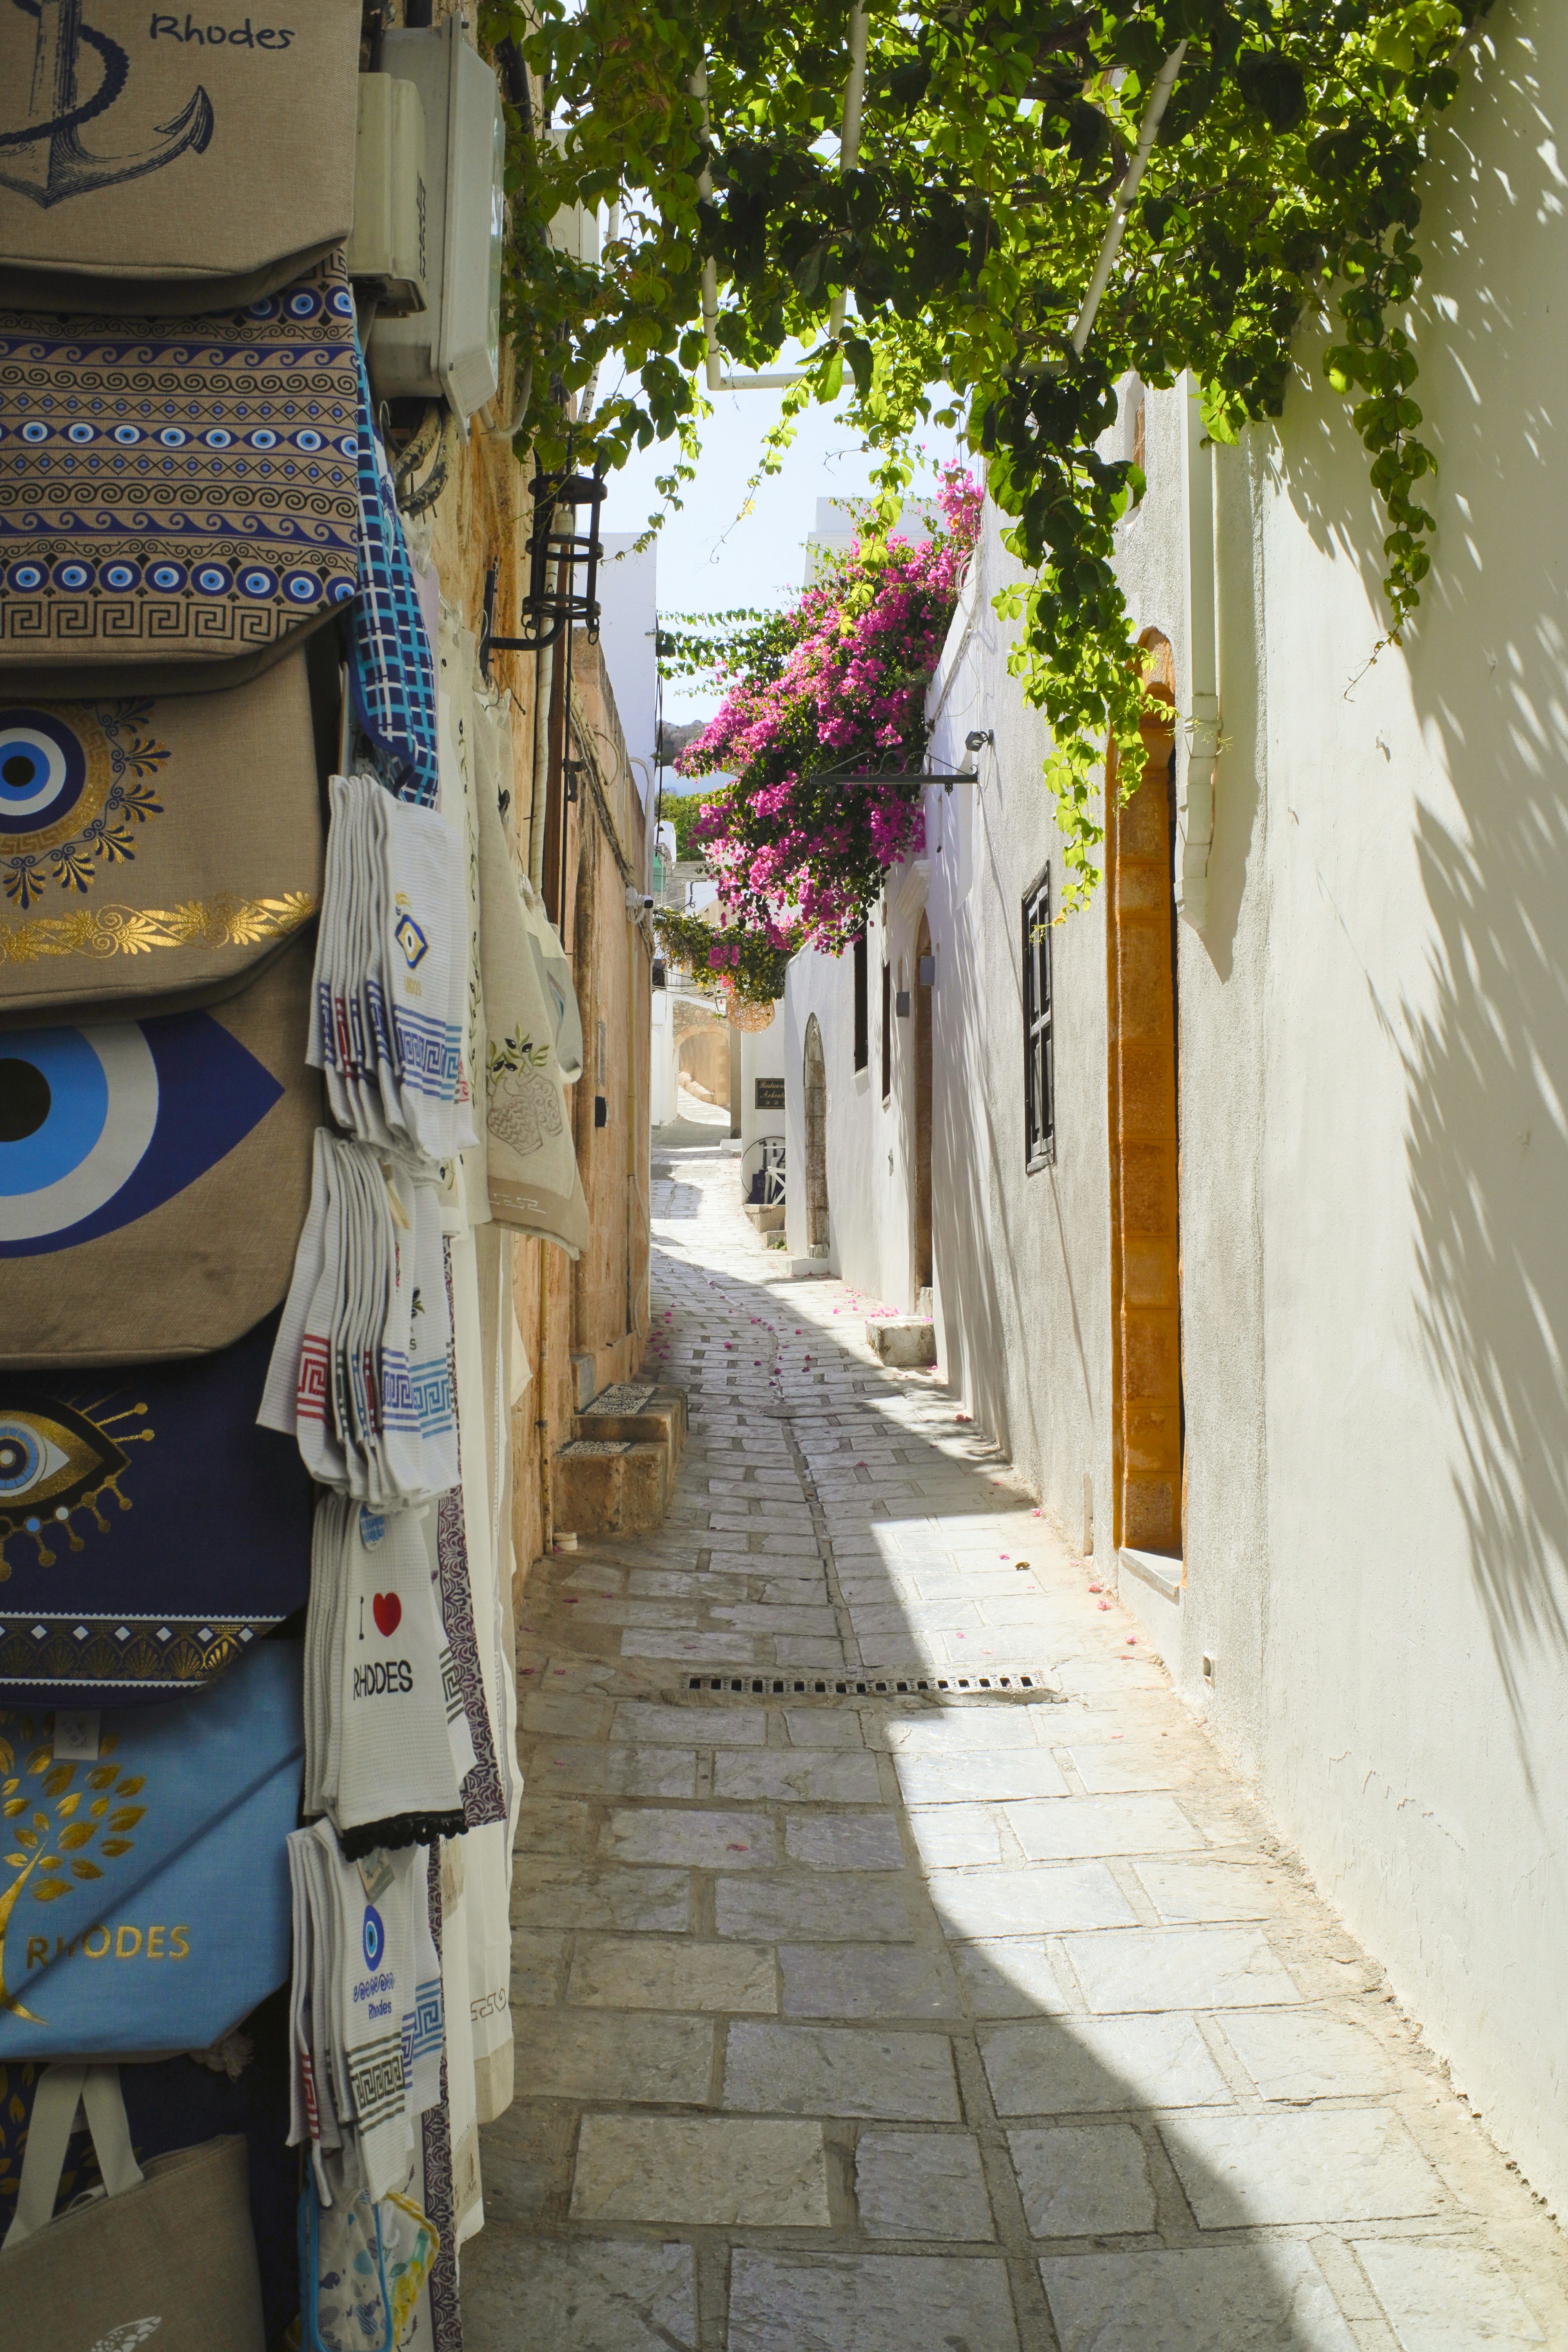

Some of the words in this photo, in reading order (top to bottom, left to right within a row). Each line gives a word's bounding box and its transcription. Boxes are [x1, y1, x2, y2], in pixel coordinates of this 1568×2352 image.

[150, 13, 295, 49] Rhodes
[359, 1596, 364, 1640] I
[354, 1659, 413, 1700] RHODES
